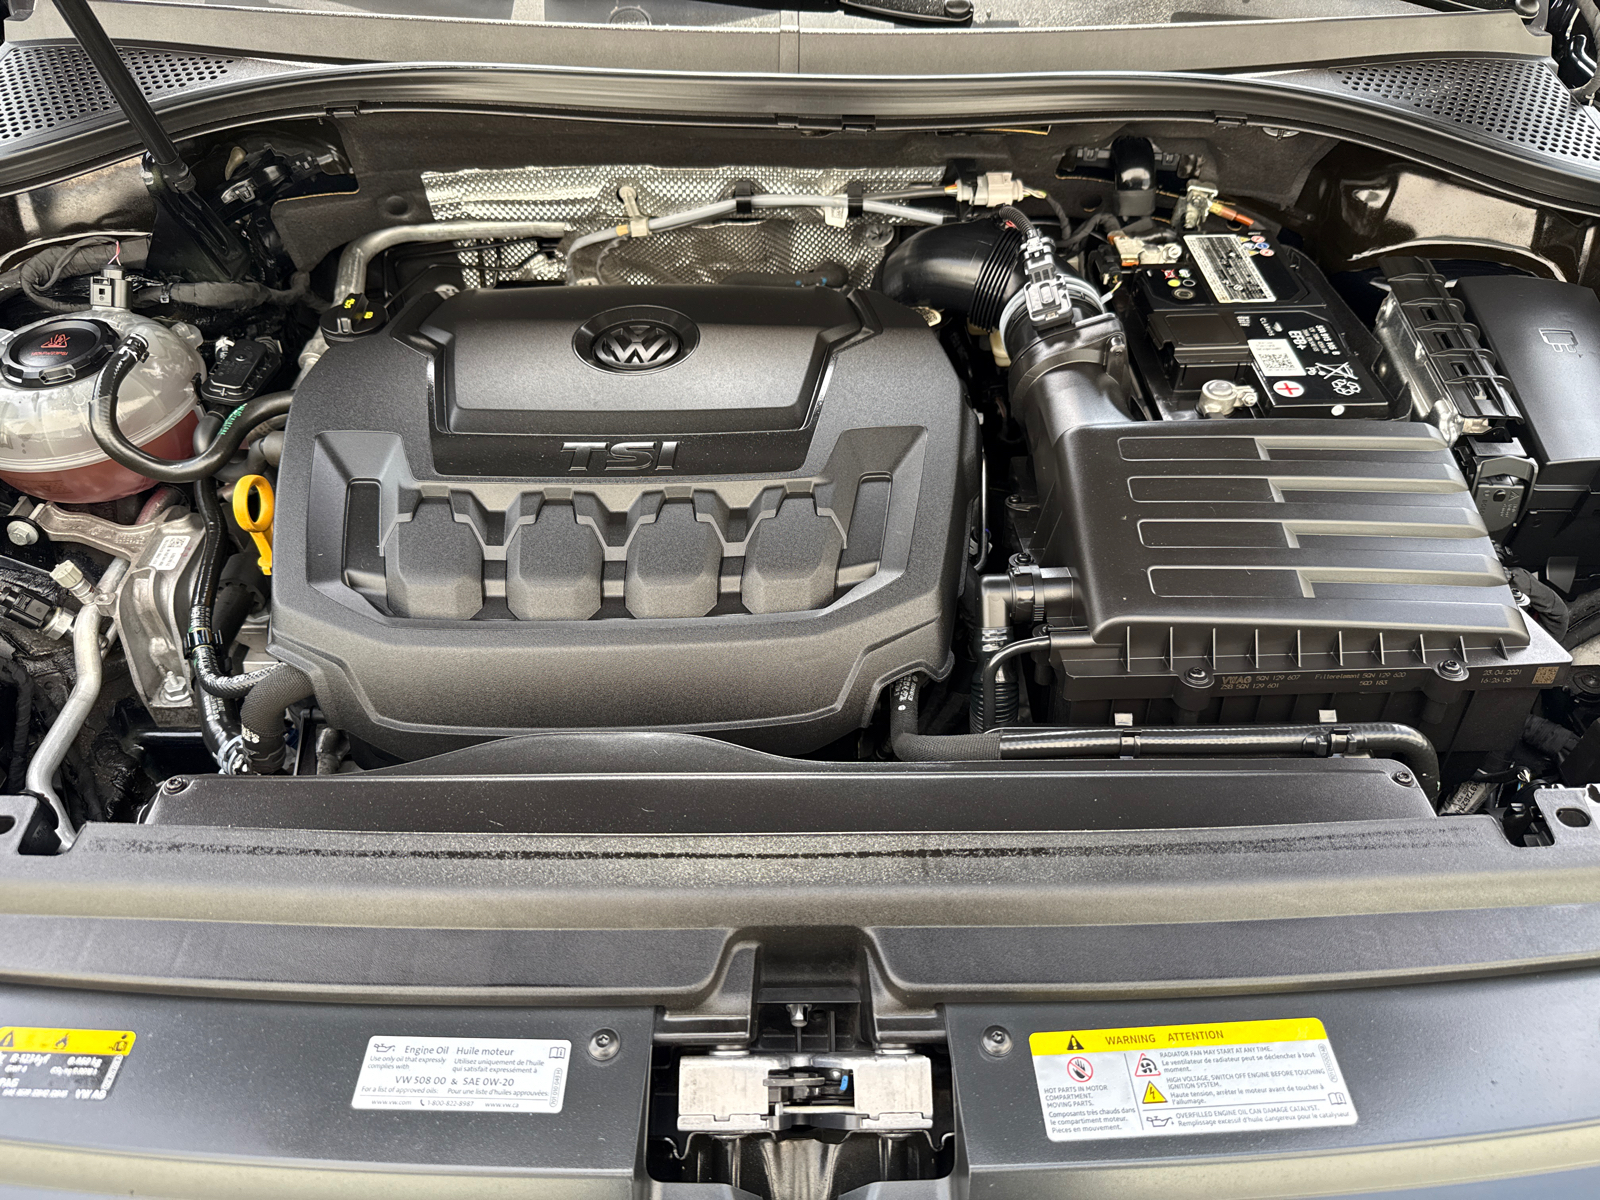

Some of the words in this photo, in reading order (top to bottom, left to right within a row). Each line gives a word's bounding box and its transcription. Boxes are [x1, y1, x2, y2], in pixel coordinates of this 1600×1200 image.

[1288, 330, 1307, 350] EFB+
[560, 441, 680, 471] TSI
[1105, 1034, 1156, 1045] WARNING
[1168, 1030, 1224, 1042] ATTENTION
[404, 1046, 434, 1056] Engine
[436, 1046, 450, 1054] Oil
[456, 1046, 480, 1056] Huile
[482, 1048, 514, 1056] moteur
[478, 1059, 516, 1067] uniquement
[489, 1066, 532, 1074] expressément
[395, 1076, 412, 1084] VW
[414, 1076, 432, 1084] 508
[433, 1076, 447, 1085] 00
[463, 1077, 481, 1086] SAE
[482, 1078, 514, 1087] 0W-20
[75, 1089, 93, 1099] VW
[90, 1089, 107, 1100] AG
[1049, 1110, 1085, 1118] Composants
[1058, 1117, 1102, 1126] compartiment
[1082, 1124, 1122, 1132] mouvement.
